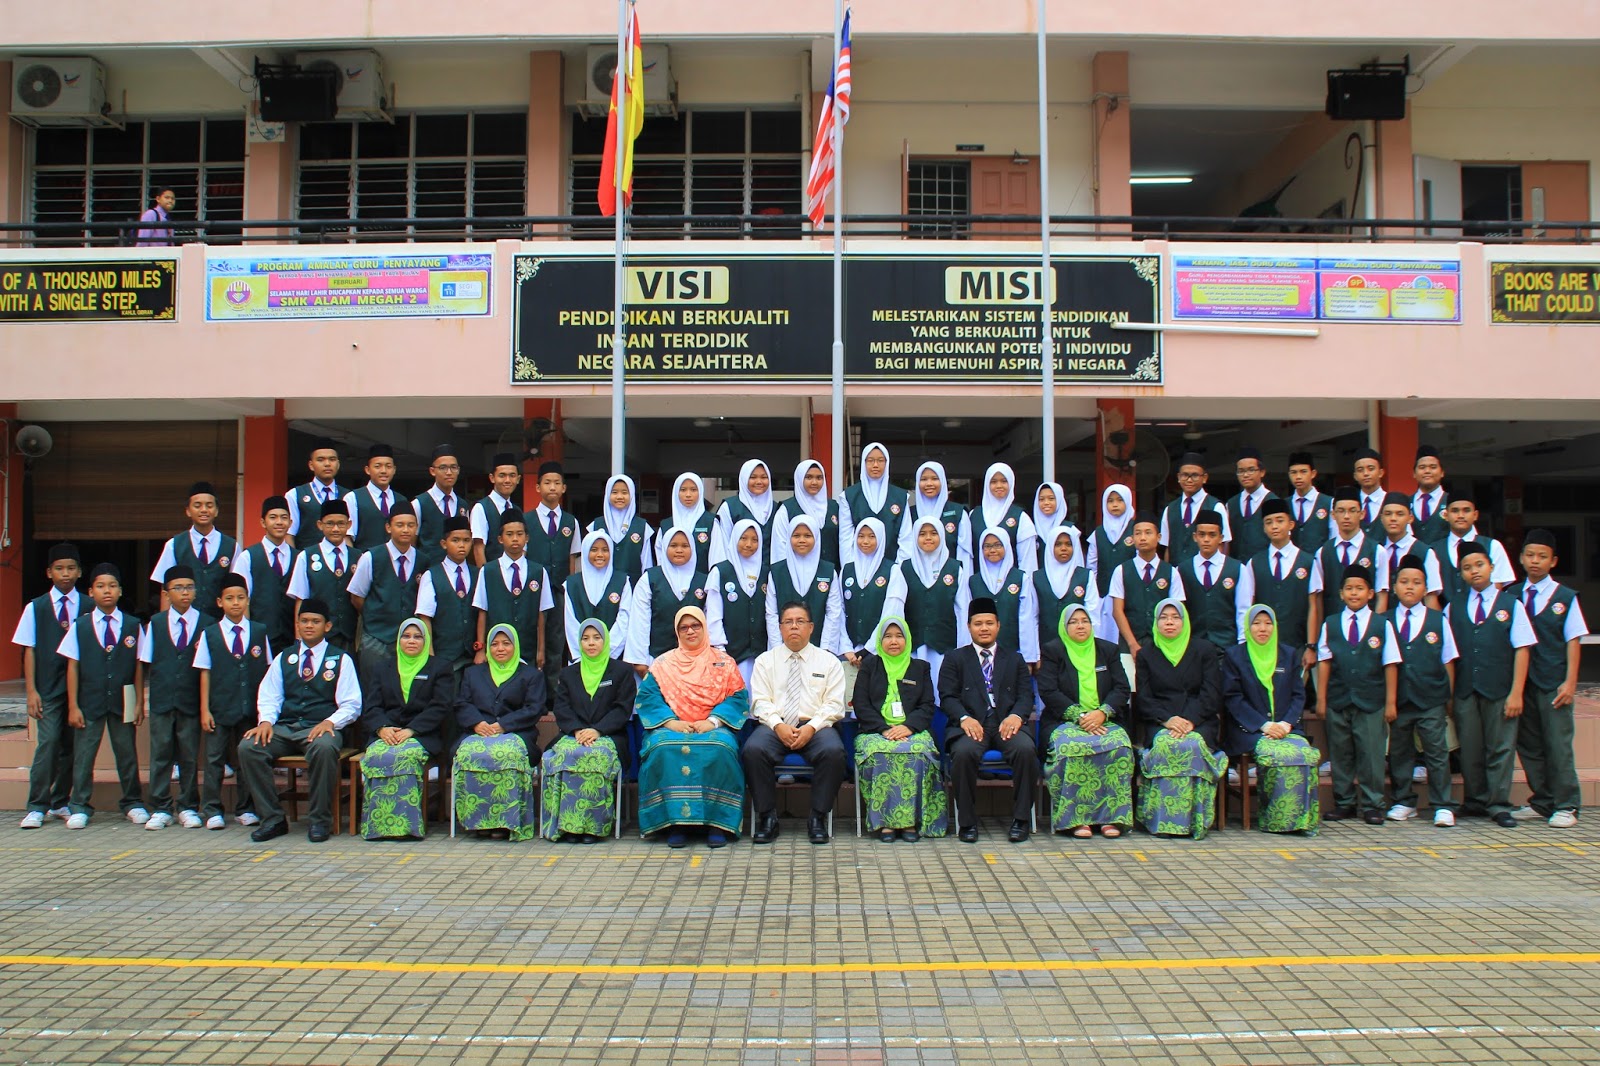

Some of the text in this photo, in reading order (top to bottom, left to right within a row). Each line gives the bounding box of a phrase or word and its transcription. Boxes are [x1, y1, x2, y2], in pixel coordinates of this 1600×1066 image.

[257, 258, 441, 271] PROGRAM AMALAN GURU PENYAYANG
[3, 270, 161, 290] OF A THOUSAND MILES
[636, 270, 712, 300] VISI
[960, 271, 1042, 300] MISI
[1504, 272, 1554, 290] BOOKS
[1558, 272, 1588, 290] ARE
[34, 294, 44, 311] A
[49, 292, 97, 311] SINGLE
[102, 292, 139, 310] STEP.
[280, 295, 417, 306] SMK ALAM MEGAH 2
[1504, 294, 1594, 312] THAT COULD
[683, 310, 790, 325] BERKUALITI
[872, 310, 1129, 323] MELESTARIKAN SISTEM ENDIDIKAN
[910, 326, 1091, 339] YANG BERKUALITI NTUK
[661, 333, 749, 348] TERDIDIK
[870, 342, 995, 354] MEMBANGUNKAN
[1066, 343, 1132, 355] INDIVIDU
[662, 354, 768, 370] SEJAHTERA
[875, 358, 1126, 370] BAGI MEMENUHI ASPIRSI NEGARA
